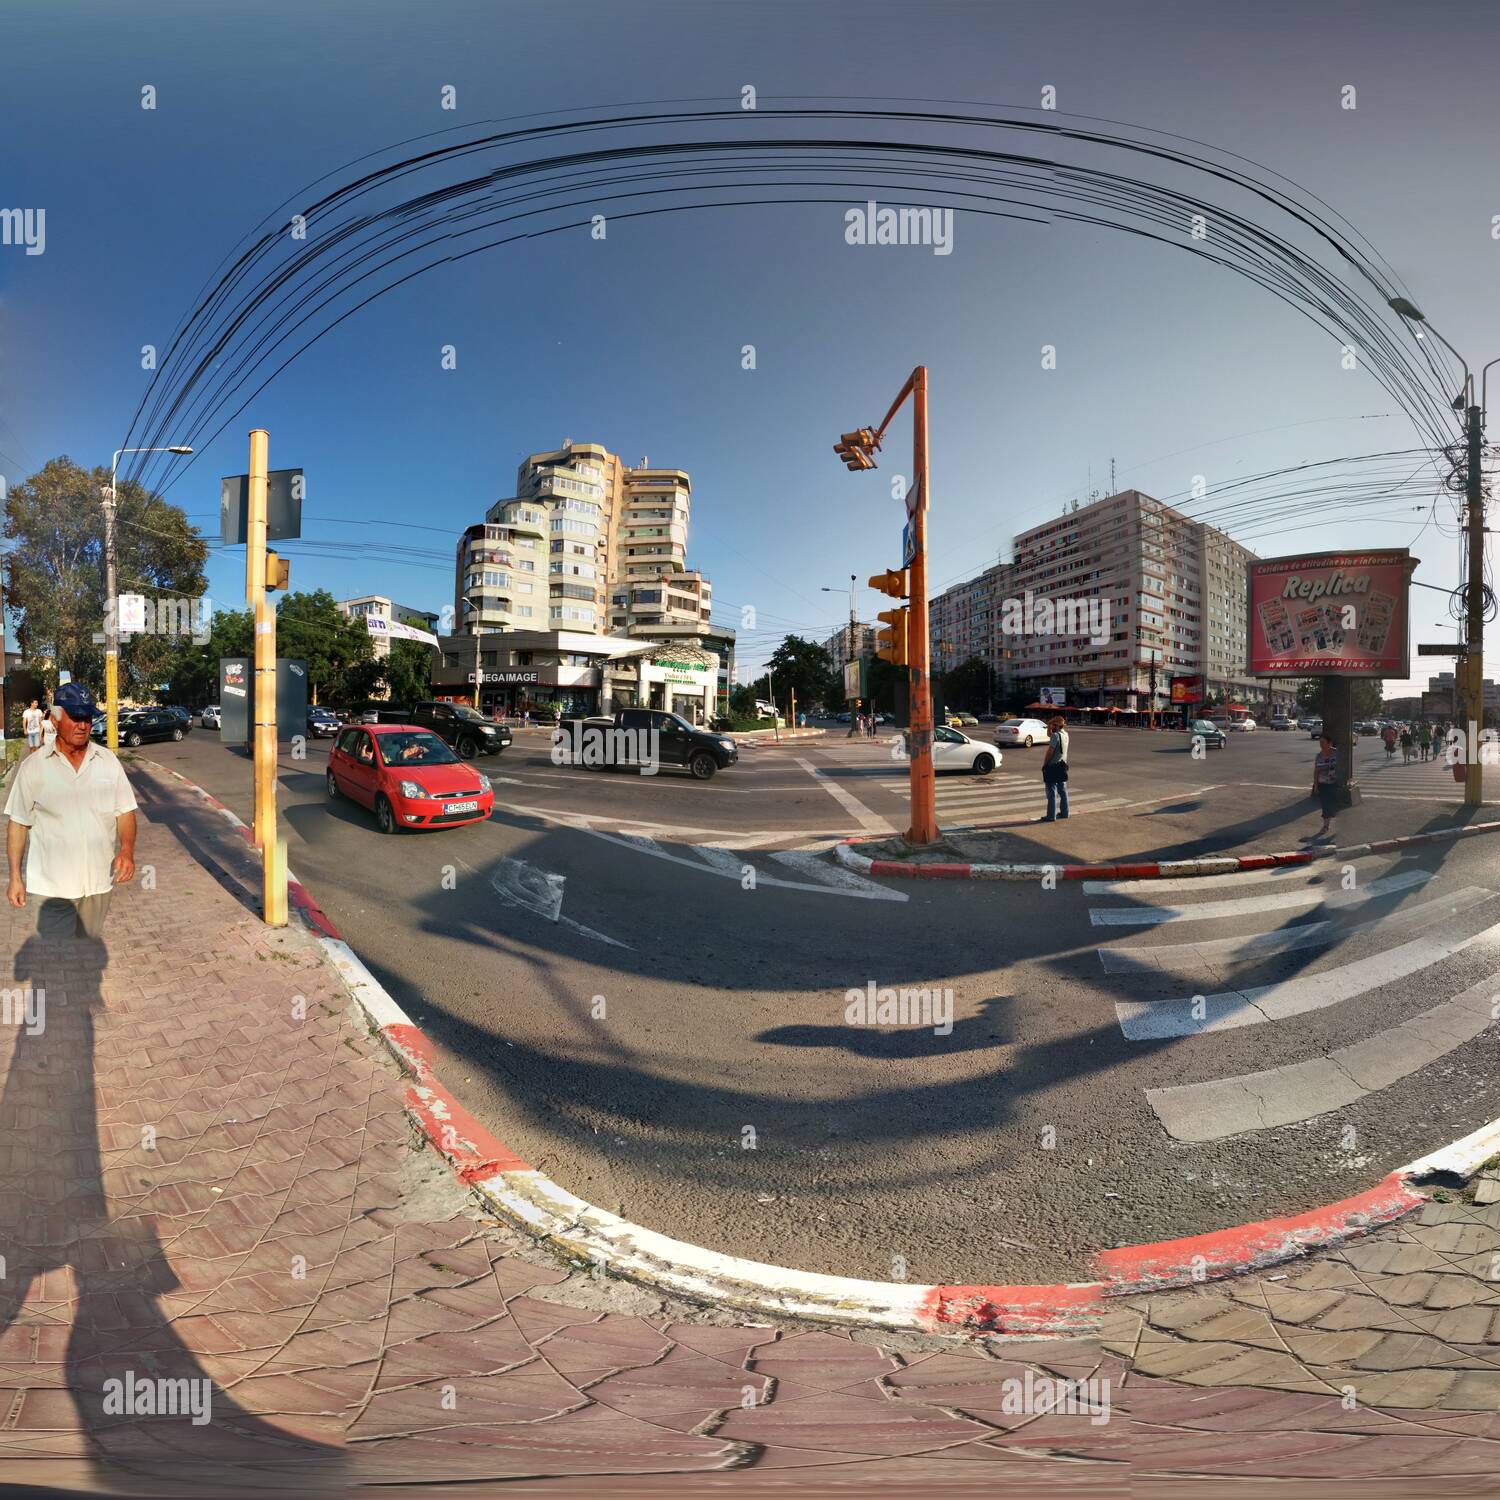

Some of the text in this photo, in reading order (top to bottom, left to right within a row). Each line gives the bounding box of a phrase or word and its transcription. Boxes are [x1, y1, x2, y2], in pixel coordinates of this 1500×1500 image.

[1283, 570, 1370, 602] Replica
[1268, 659, 1381, 669] www.replicaonline.ro
[506, 673, 537, 682] IMAGE
